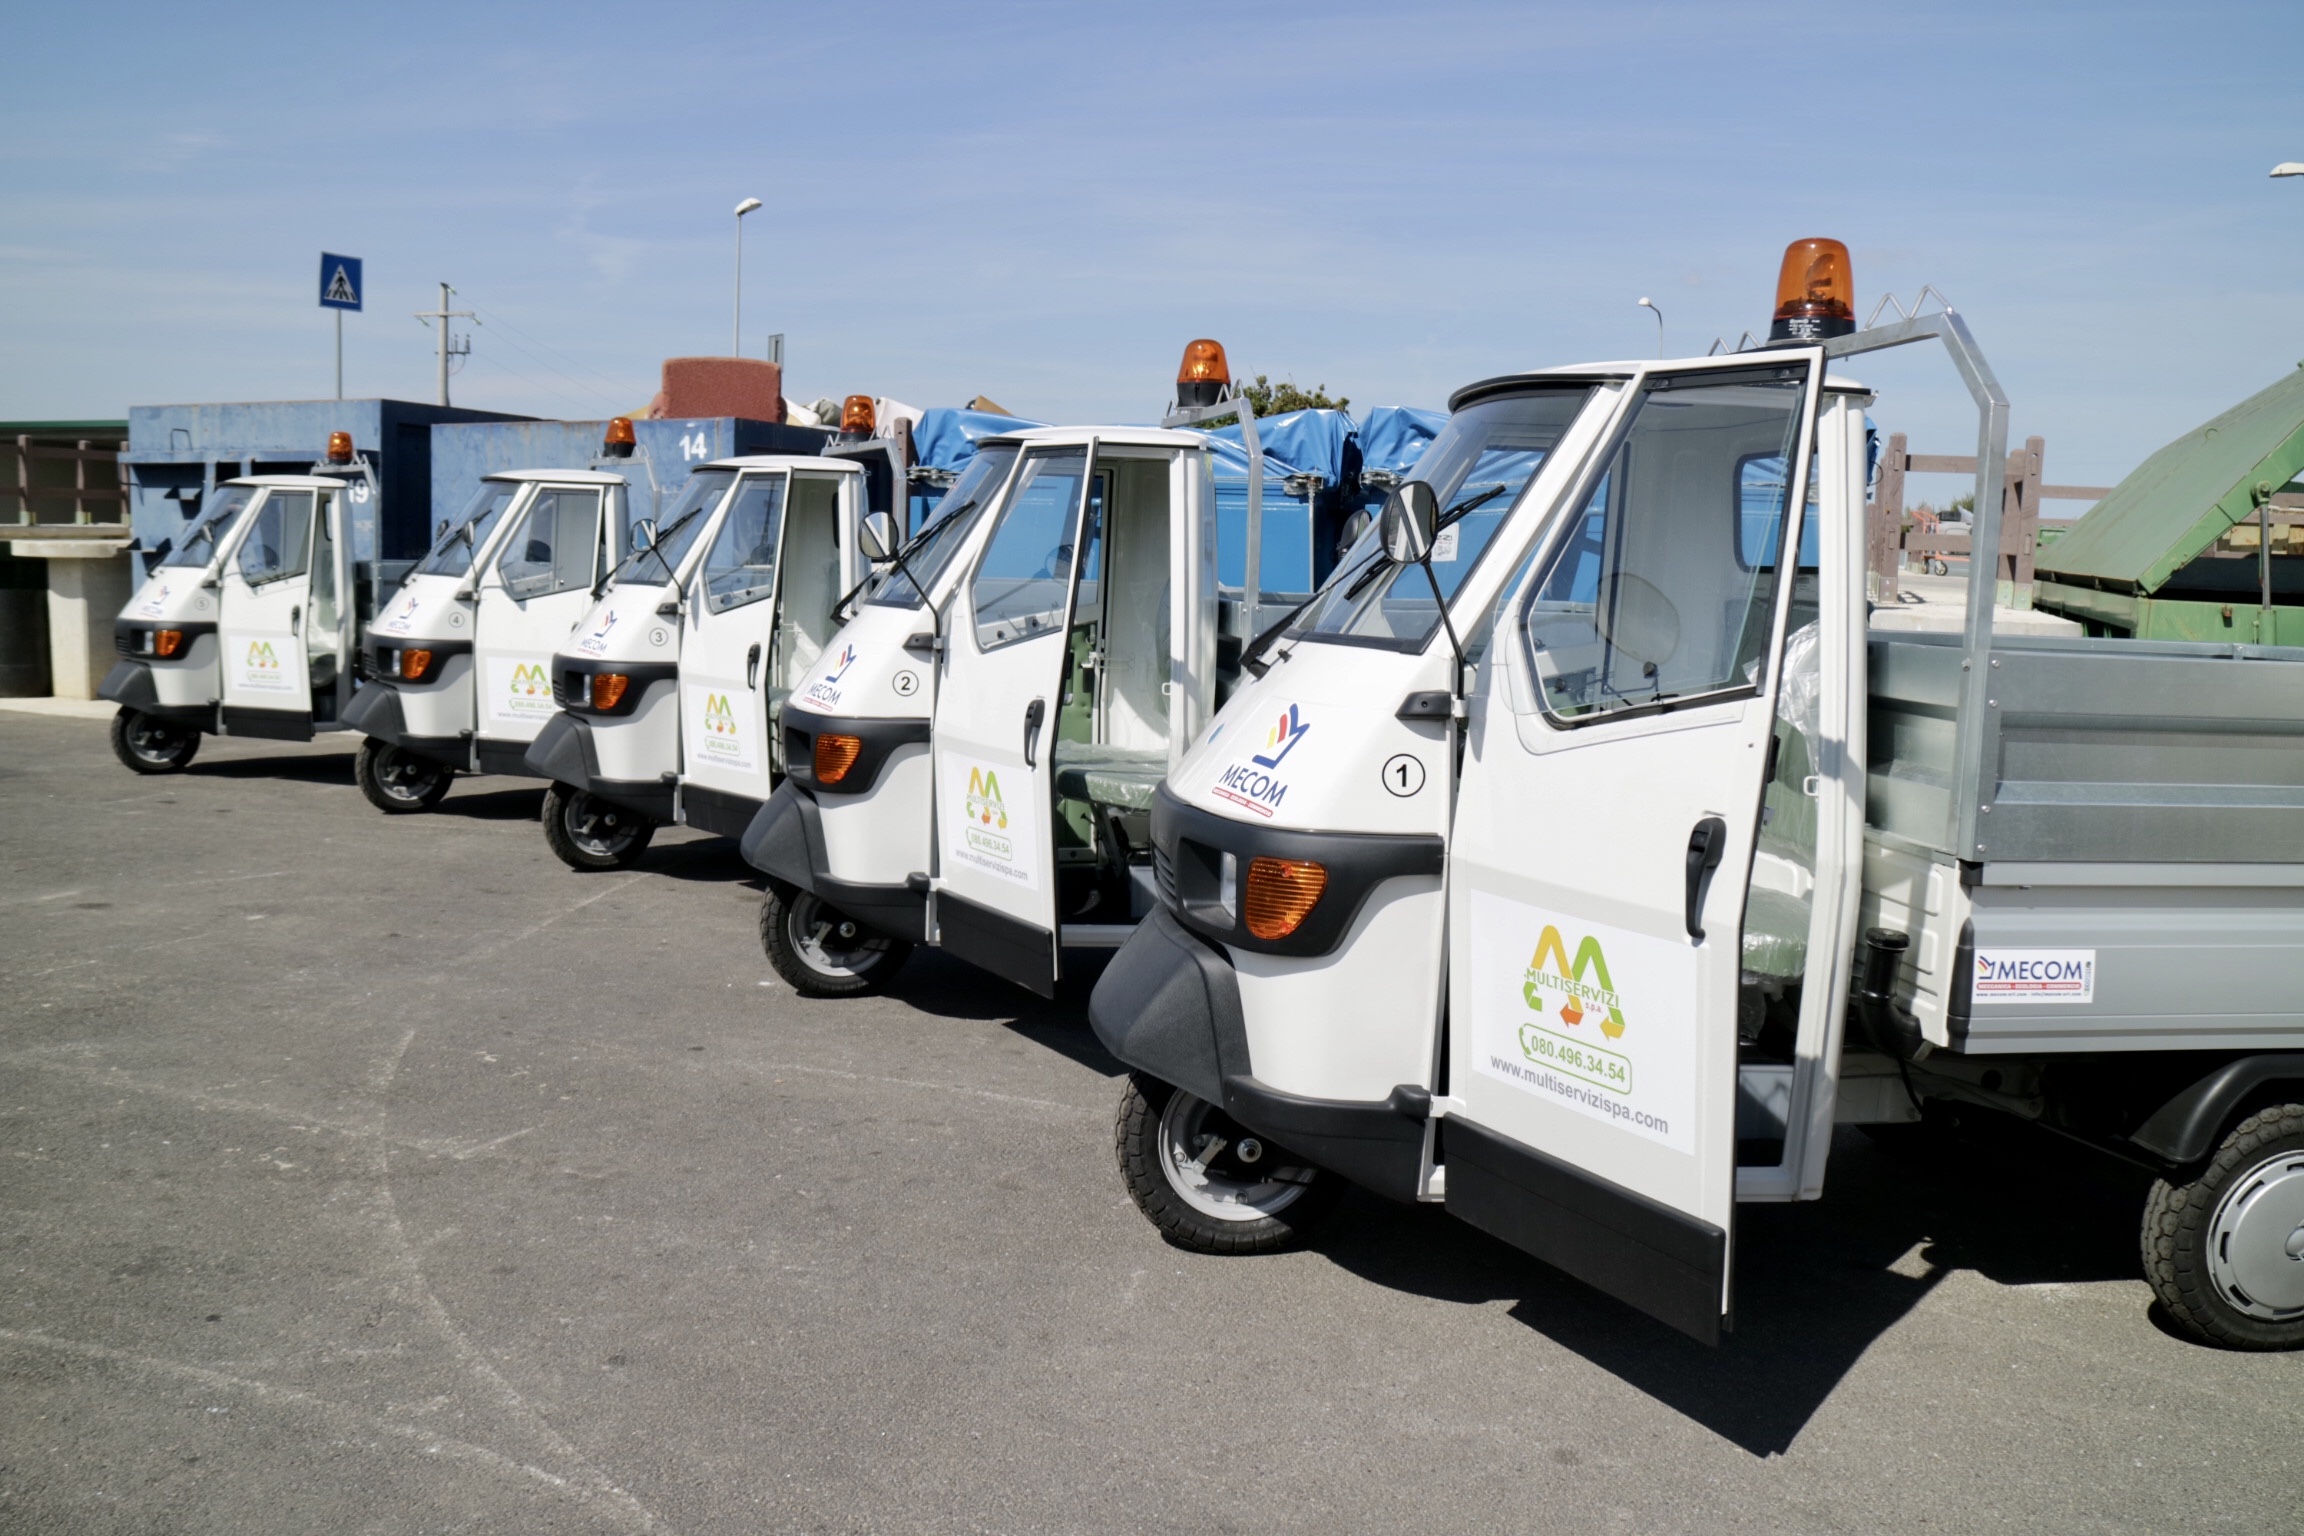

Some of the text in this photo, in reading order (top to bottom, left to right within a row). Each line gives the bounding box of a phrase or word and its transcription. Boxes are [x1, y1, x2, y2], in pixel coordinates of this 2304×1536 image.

[679, 432, 707, 461] 14
[348, 479, 369, 503] 19
[655, 632, 663, 642] 3
[808, 683, 842, 705] MECOM
[901, 677, 911, 690] 2
[1218, 763, 1288, 807] MECOM
[1396, 763, 1408, 787] 1
[1997, 961, 2082, 980] MECOM
[1526, 967, 1619, 1008] MULTISERVIZI
[1531, 1035, 1625, 1082] 080.496.34.54
[1491, 1055, 1668, 1134] www.multiservizispa.com
